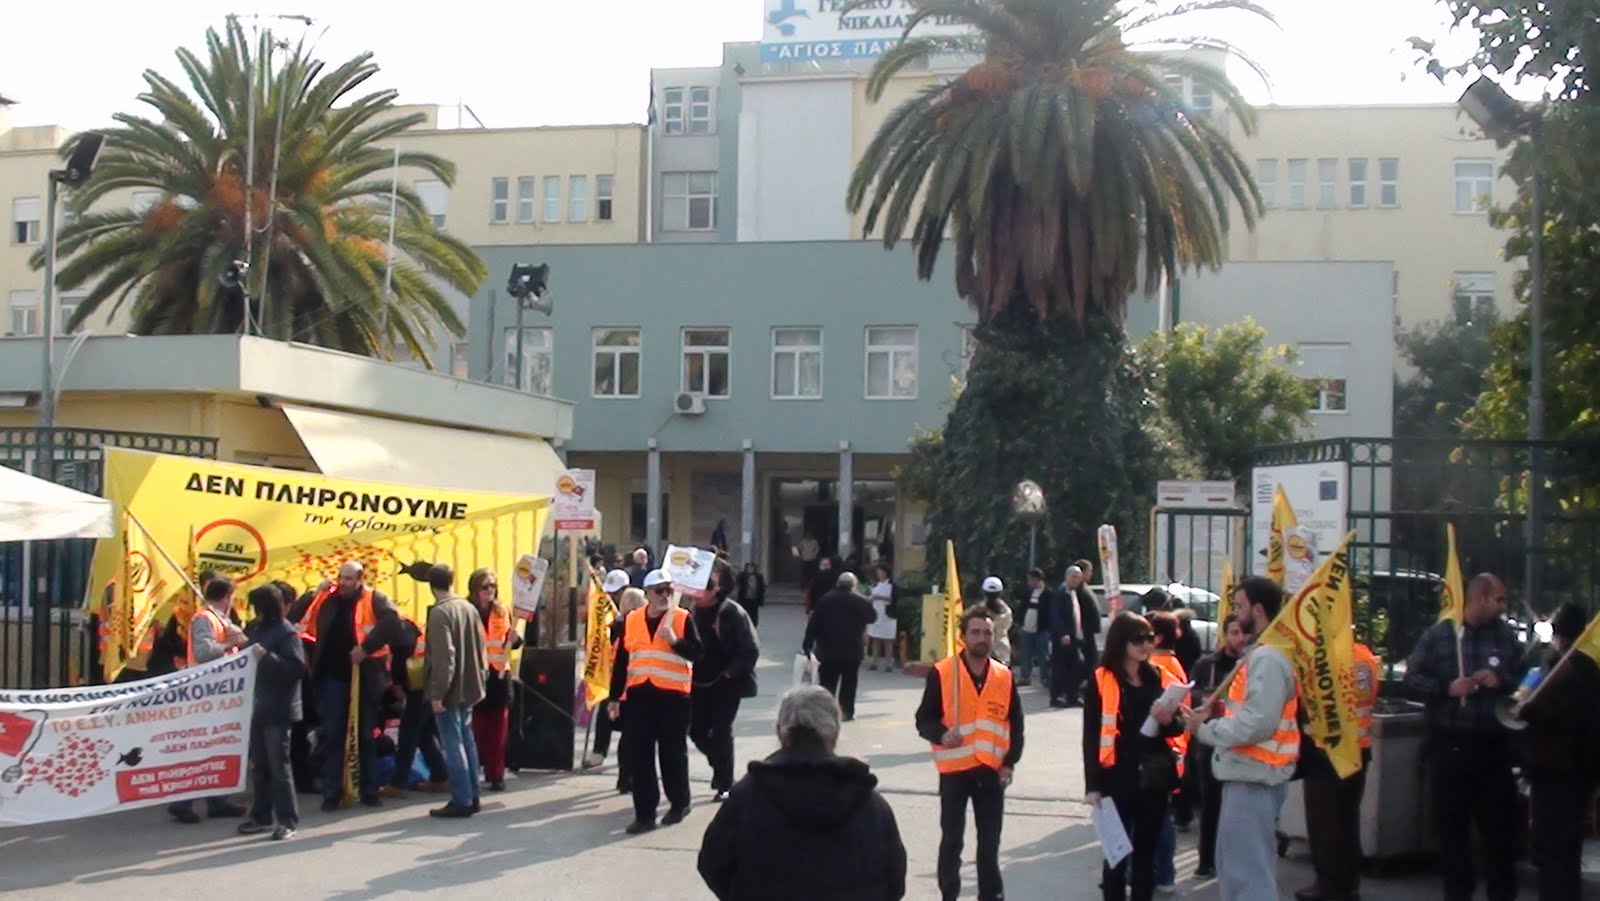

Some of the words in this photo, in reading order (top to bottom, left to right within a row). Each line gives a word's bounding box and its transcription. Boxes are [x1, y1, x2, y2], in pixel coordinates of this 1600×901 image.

[185, 472, 245, 497] ΔΕΝ
[255, 480, 468, 520] ΠΛΗΡΩΝΟΥΜΕ
[215, 542, 245, 554] ΔΕΝ
[52, 718, 71, 732] ΤΟ
